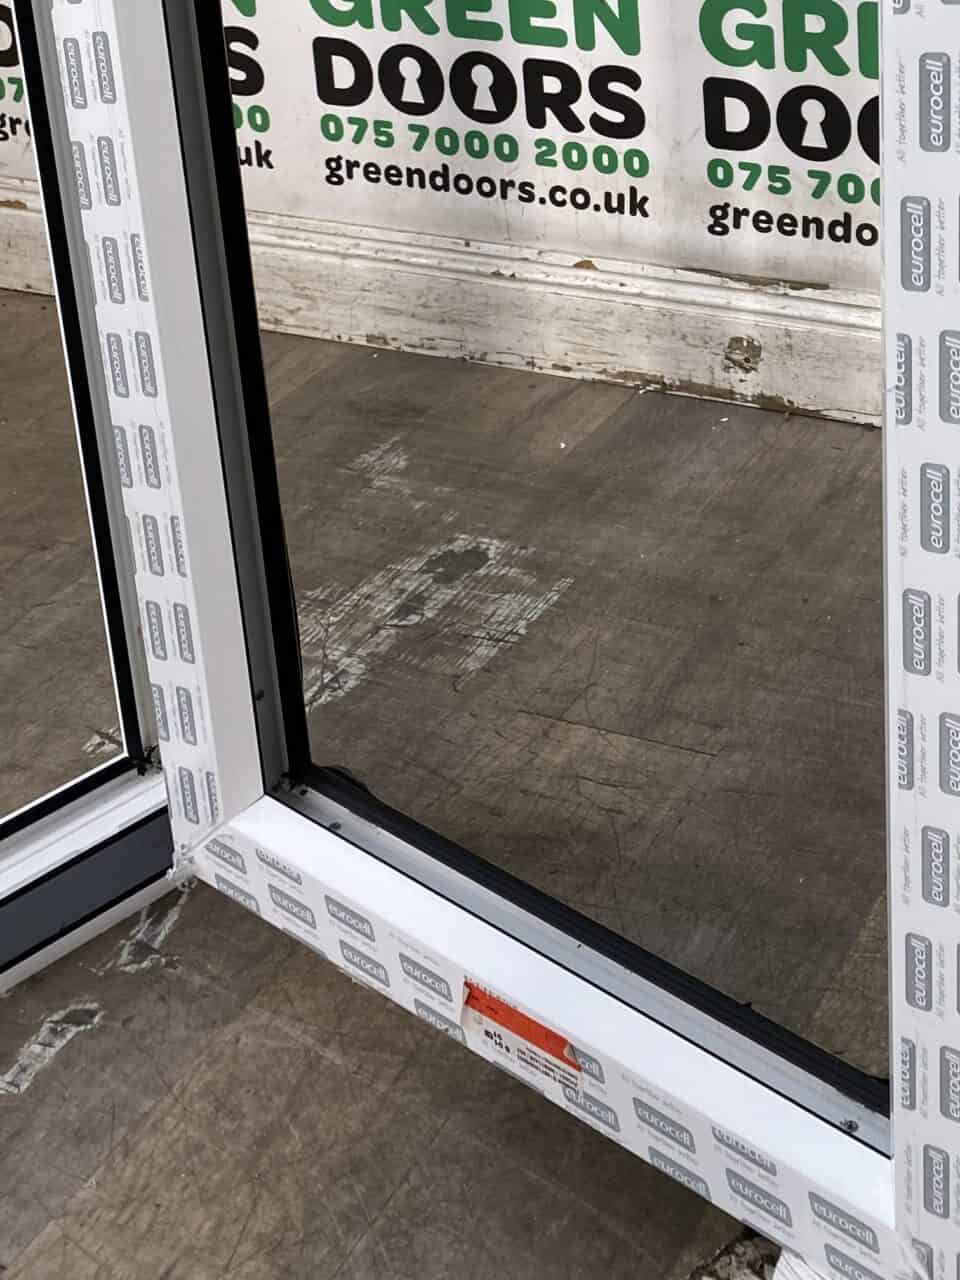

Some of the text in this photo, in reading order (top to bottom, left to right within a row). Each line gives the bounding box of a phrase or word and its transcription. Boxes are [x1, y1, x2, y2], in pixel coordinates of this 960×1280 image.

[65, 41, 86, 109] eurocell
[95, 34, 115, 102] eurocell
[312, 36, 646, 140] DOORS
[925, 58, 944, 147] eurocell
[100, 138, 120, 206] eurocell
[319, 113, 650, 178] 075 7000 2000
[706, 159, 792, 196] 075
[324, 155, 650, 219] greendoors.co.uk
[906, 201, 925, 287] eurocell
[925, 468, 944, 549] eurocell
[908, 593, 925, 671] eurocell
[927, 831, 944, 902] eurocell
[910, 936, 927, 1006] eurocell
[944, 1052, 960, 1119] eurocell
[928, 1150, 944, 1214] eurocell
